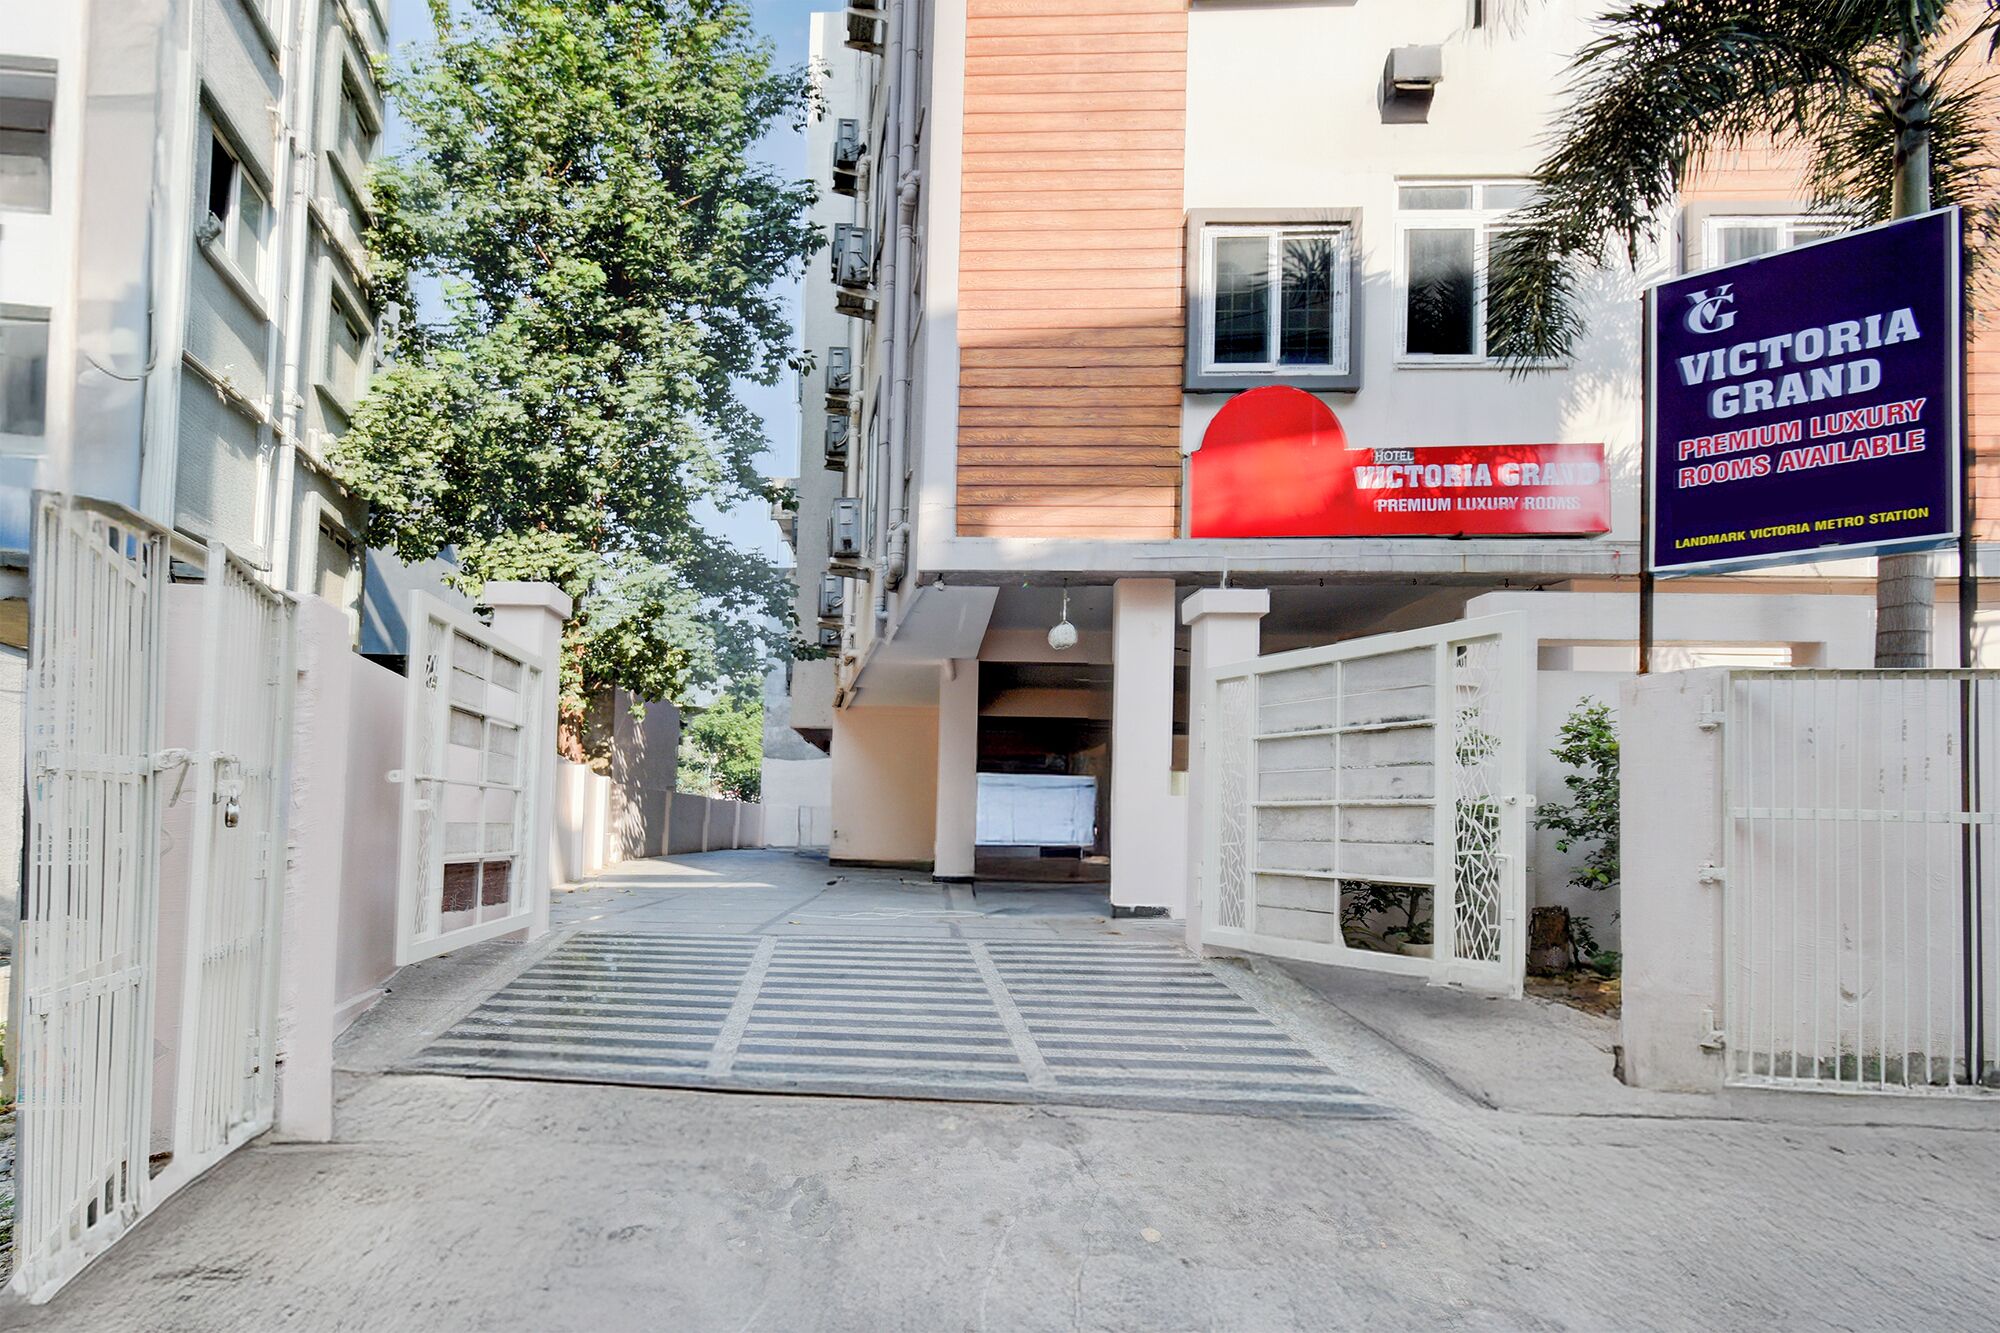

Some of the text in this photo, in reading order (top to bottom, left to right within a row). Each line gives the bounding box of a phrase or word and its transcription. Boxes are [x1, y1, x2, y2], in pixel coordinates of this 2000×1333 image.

[1678, 307, 1920, 386] VICTORIA
[1710, 358, 1881, 419] GRAND
[1677, 398, 1926, 461] PREMIUM LUXURY
[1353, 462, 1601, 489] VICTORIA GRAND
[1374, 451, 1414, 462] HOTEL
[1677, 428, 1926, 489] ROOMS AVAILABLE
[1375, 496, 1580, 512] PREMIUM LUXURY ROOMS
[1675, 507, 1930, 549] LANDMARK VICTORIA METRO STATION
